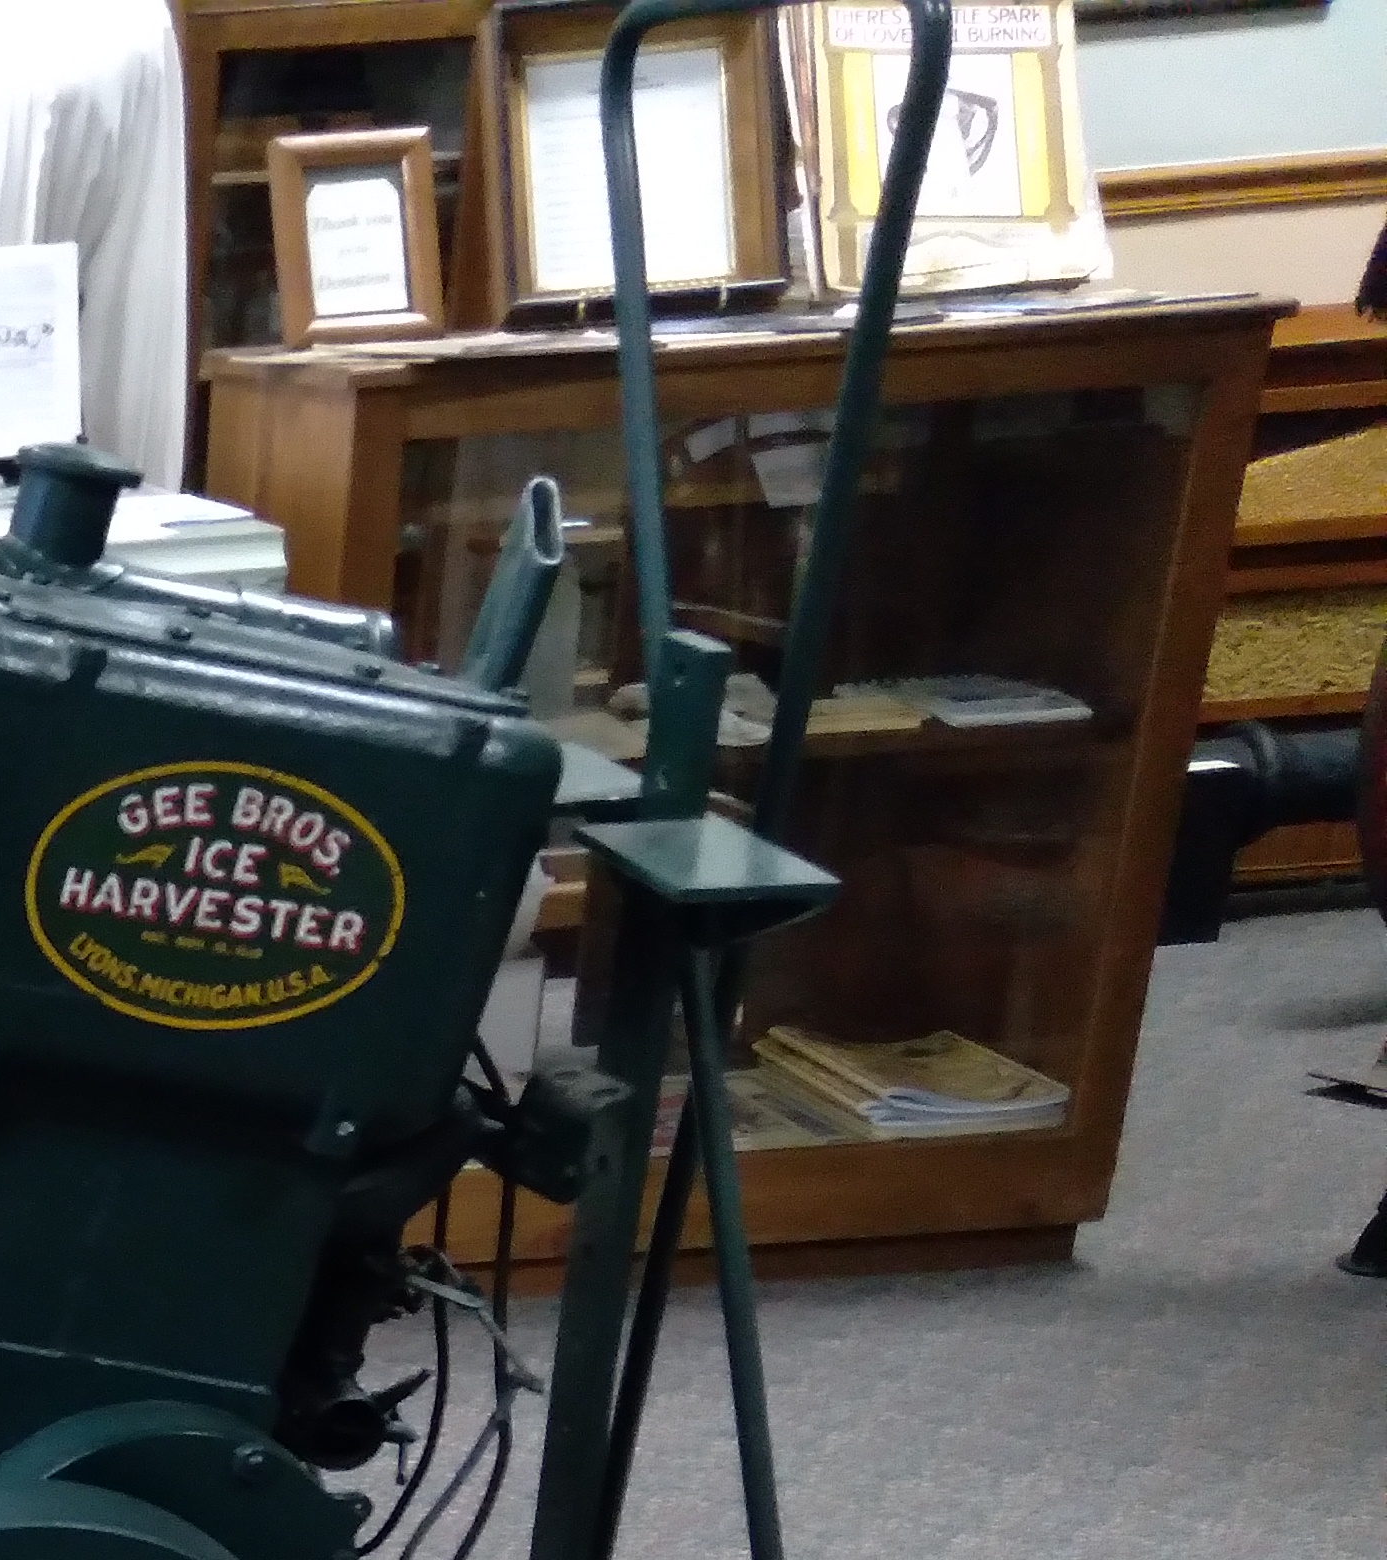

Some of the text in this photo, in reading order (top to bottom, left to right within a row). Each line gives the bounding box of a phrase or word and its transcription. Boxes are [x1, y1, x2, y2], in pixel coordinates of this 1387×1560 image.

[968, 27, 1046, 42] BURNING
[988, 8, 1043, 24] SPARK
[118, 783, 217, 837] GEE
[184, 836, 267, 886] ICE
[59, 866, 366, 953] HARVESTER
